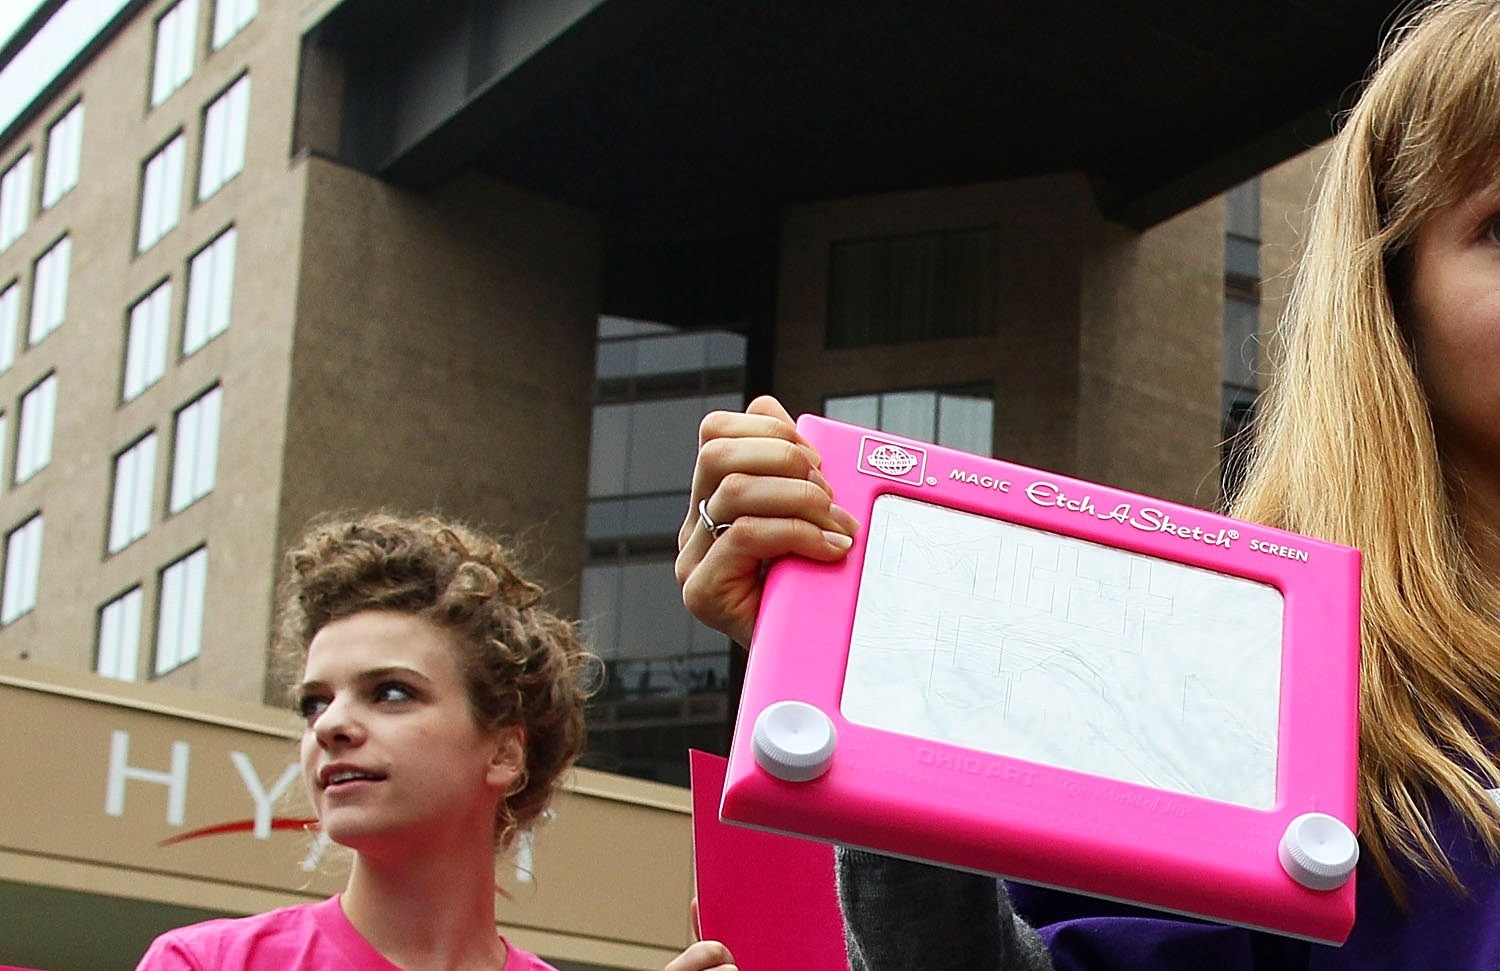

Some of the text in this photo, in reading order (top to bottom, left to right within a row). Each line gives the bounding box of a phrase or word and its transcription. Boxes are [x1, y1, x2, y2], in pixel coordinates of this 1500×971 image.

[950, 469, 1011, 492] MAGIC
[1025, 481, 1095, 516] Etch
[1097, 504, 1129, 523] A
[1249, 539, 1309, 562] SCREEN
